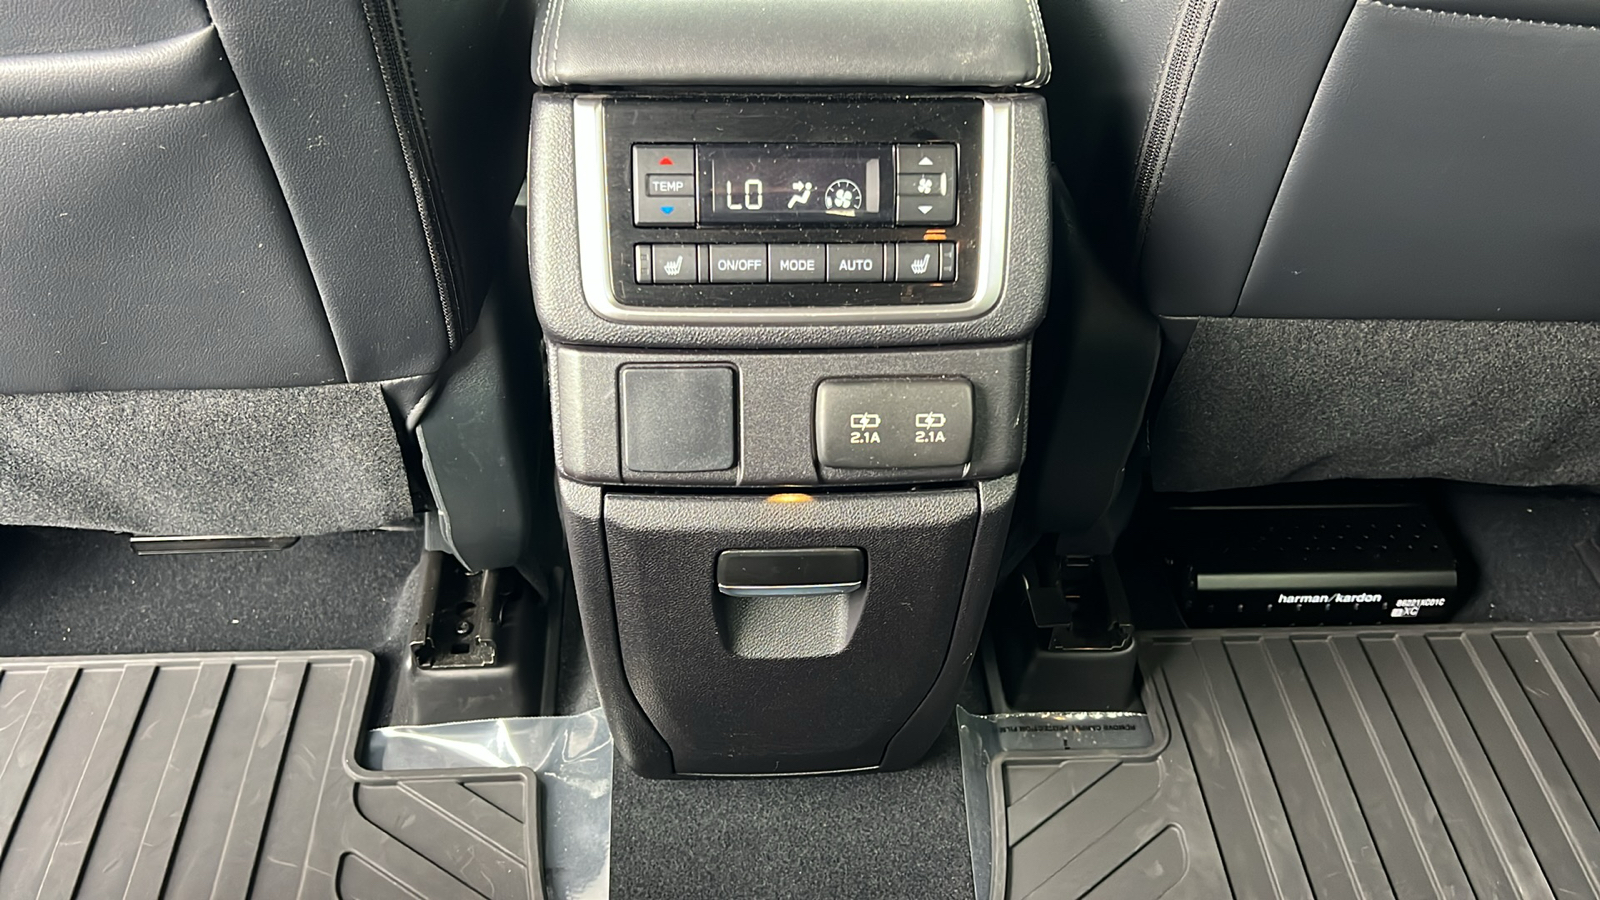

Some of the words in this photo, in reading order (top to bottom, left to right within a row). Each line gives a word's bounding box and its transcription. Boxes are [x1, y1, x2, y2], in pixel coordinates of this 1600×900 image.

[652, 180, 684, 193] TEMP
[717, 258, 762, 272] ON/OFF
[779, 259, 815, 272] MODE
[838, 258, 873, 272] AUTO
[850, 432, 881, 444] 2.1A
[915, 431, 946, 443] 2.1A
[1278, 592, 1382, 604] harman/kardon
